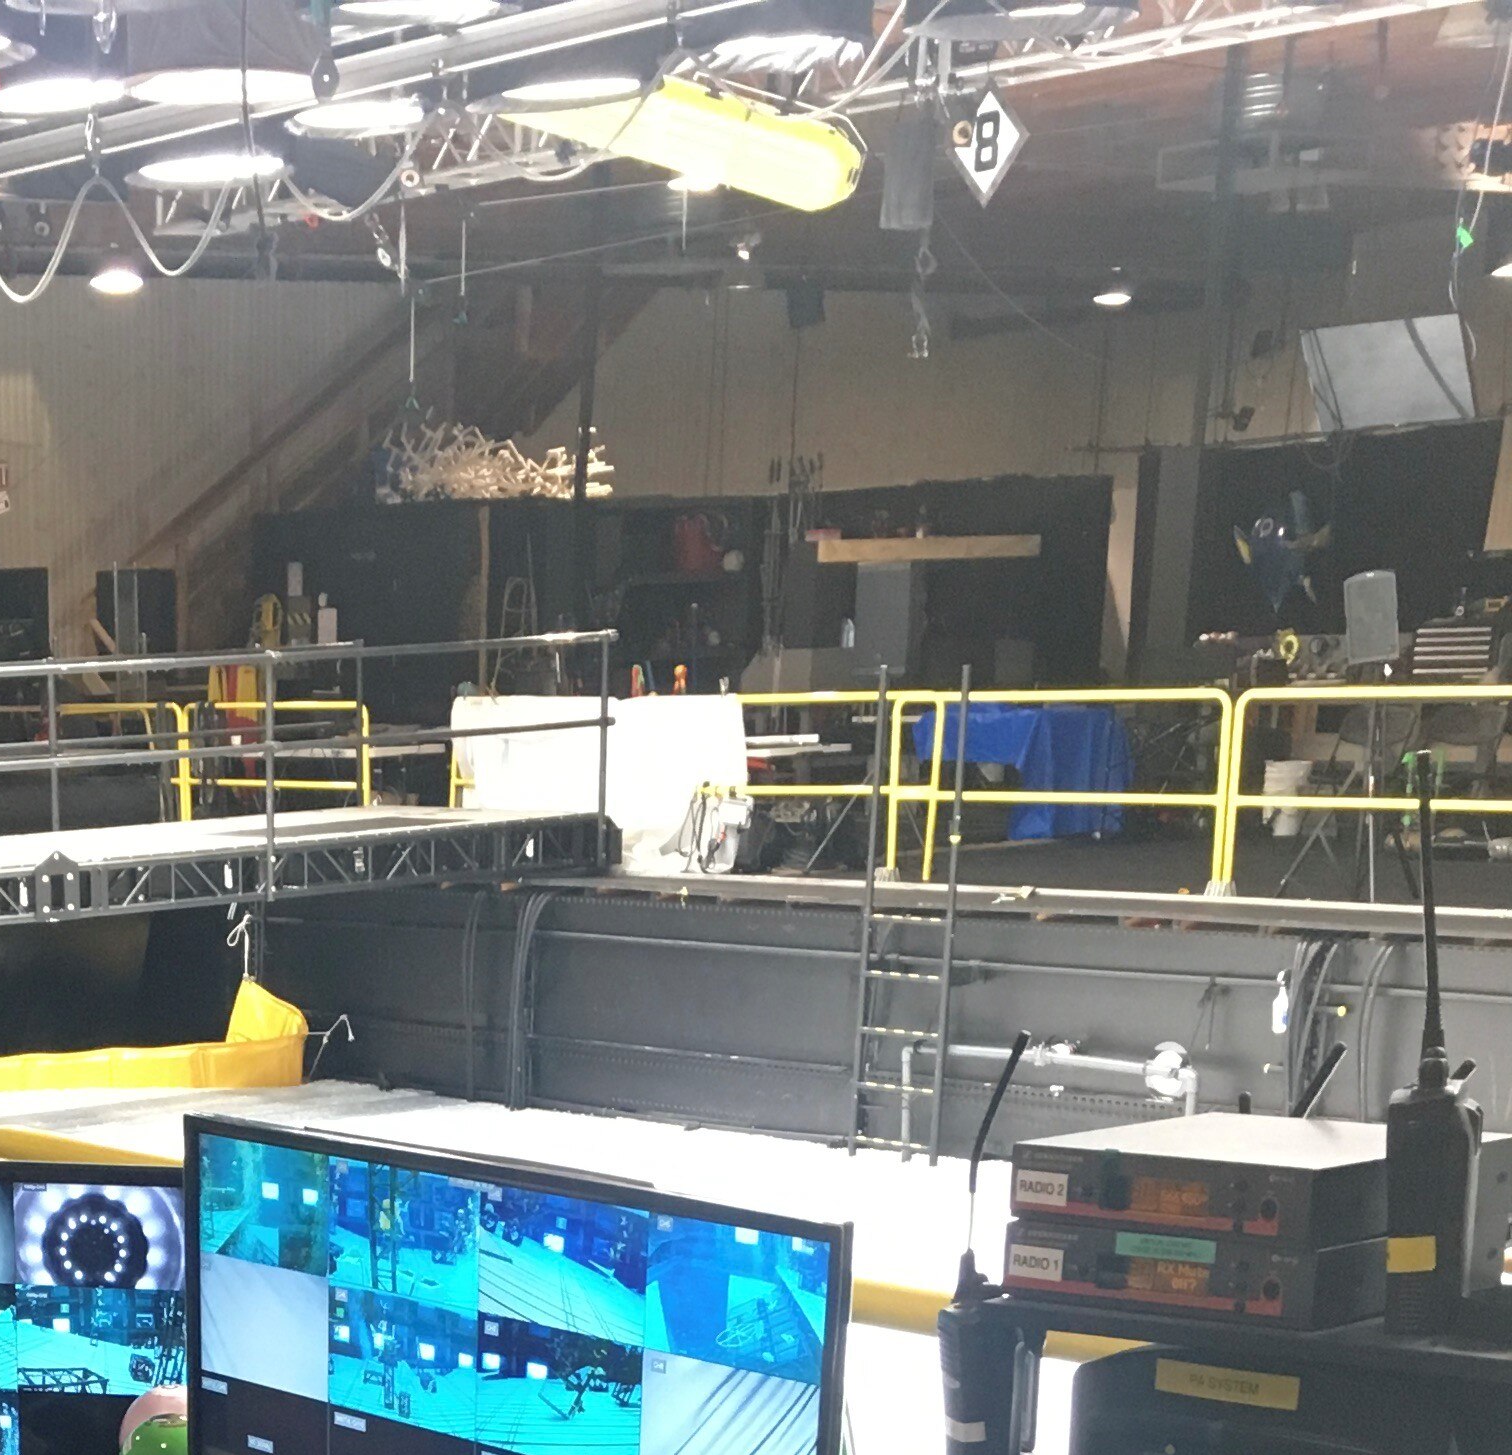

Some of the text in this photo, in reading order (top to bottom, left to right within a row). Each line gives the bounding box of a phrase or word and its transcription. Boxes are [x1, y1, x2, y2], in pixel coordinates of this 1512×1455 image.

[974, 110, 1000, 172] 8
[1019, 1179, 1065, 1196] RADIO 2
[1013, 1253, 1059, 1271] RADIO 1
[1208, 1376, 1260, 1396] SYSTEM
